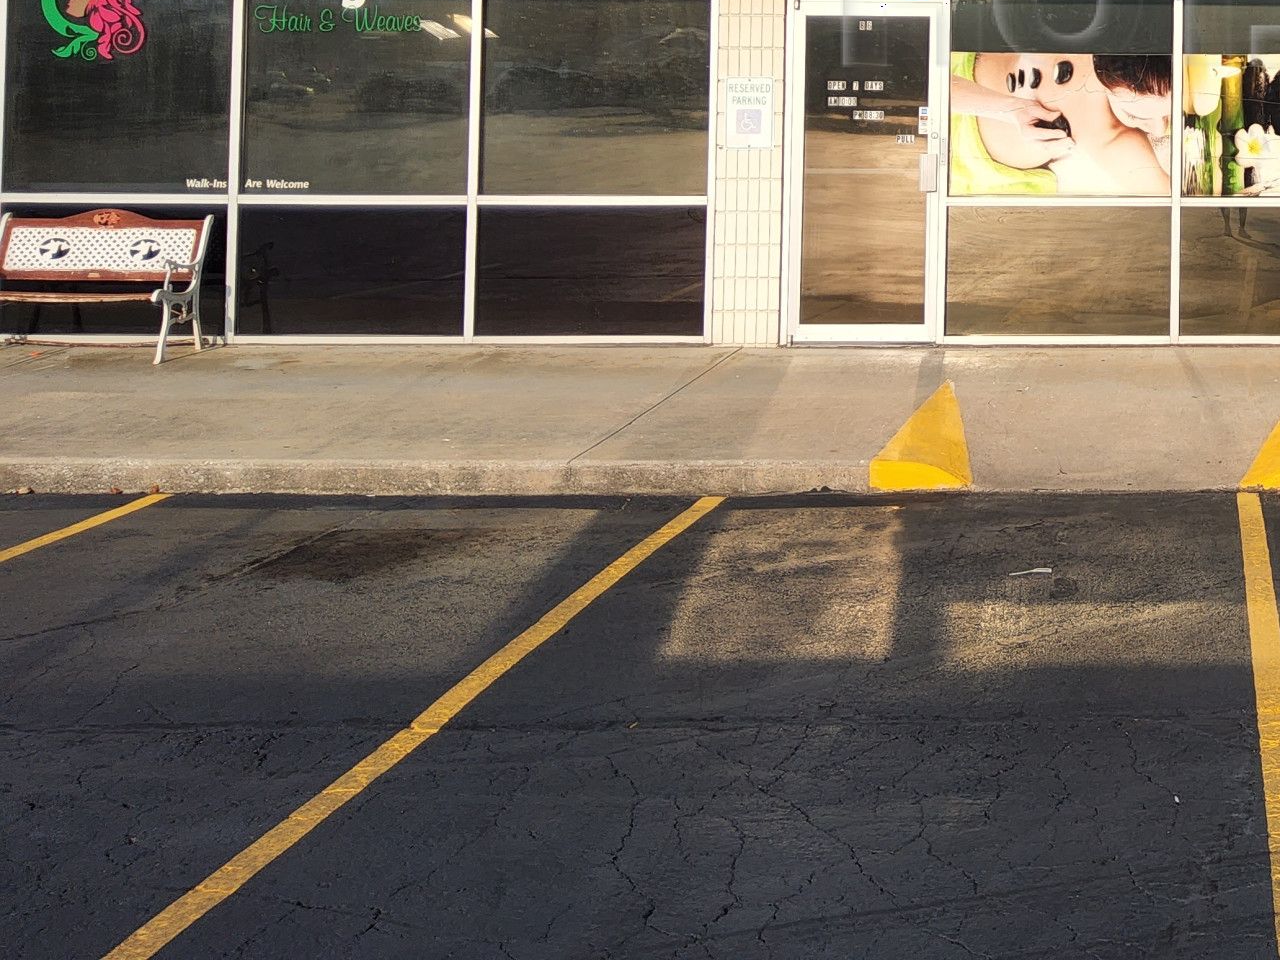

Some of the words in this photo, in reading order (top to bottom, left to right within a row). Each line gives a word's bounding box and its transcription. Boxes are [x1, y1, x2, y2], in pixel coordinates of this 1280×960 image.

[254, 4, 311, 33] Hair
[318, 8, 336, 32] &
[341, 4, 422, 32] Weaves
[728, 83, 771, 93] RESERVED
[828, 81, 846, 91] OPEN
[865, 81, 883, 91] DAYS
[732, 95, 767, 106] PARKING
[896, 135, 915, 144] PULL
[185, 178, 228, 189] Walk-Ins
[244, 178, 263, 188] Are
[266, 179, 310, 189] Welcome
